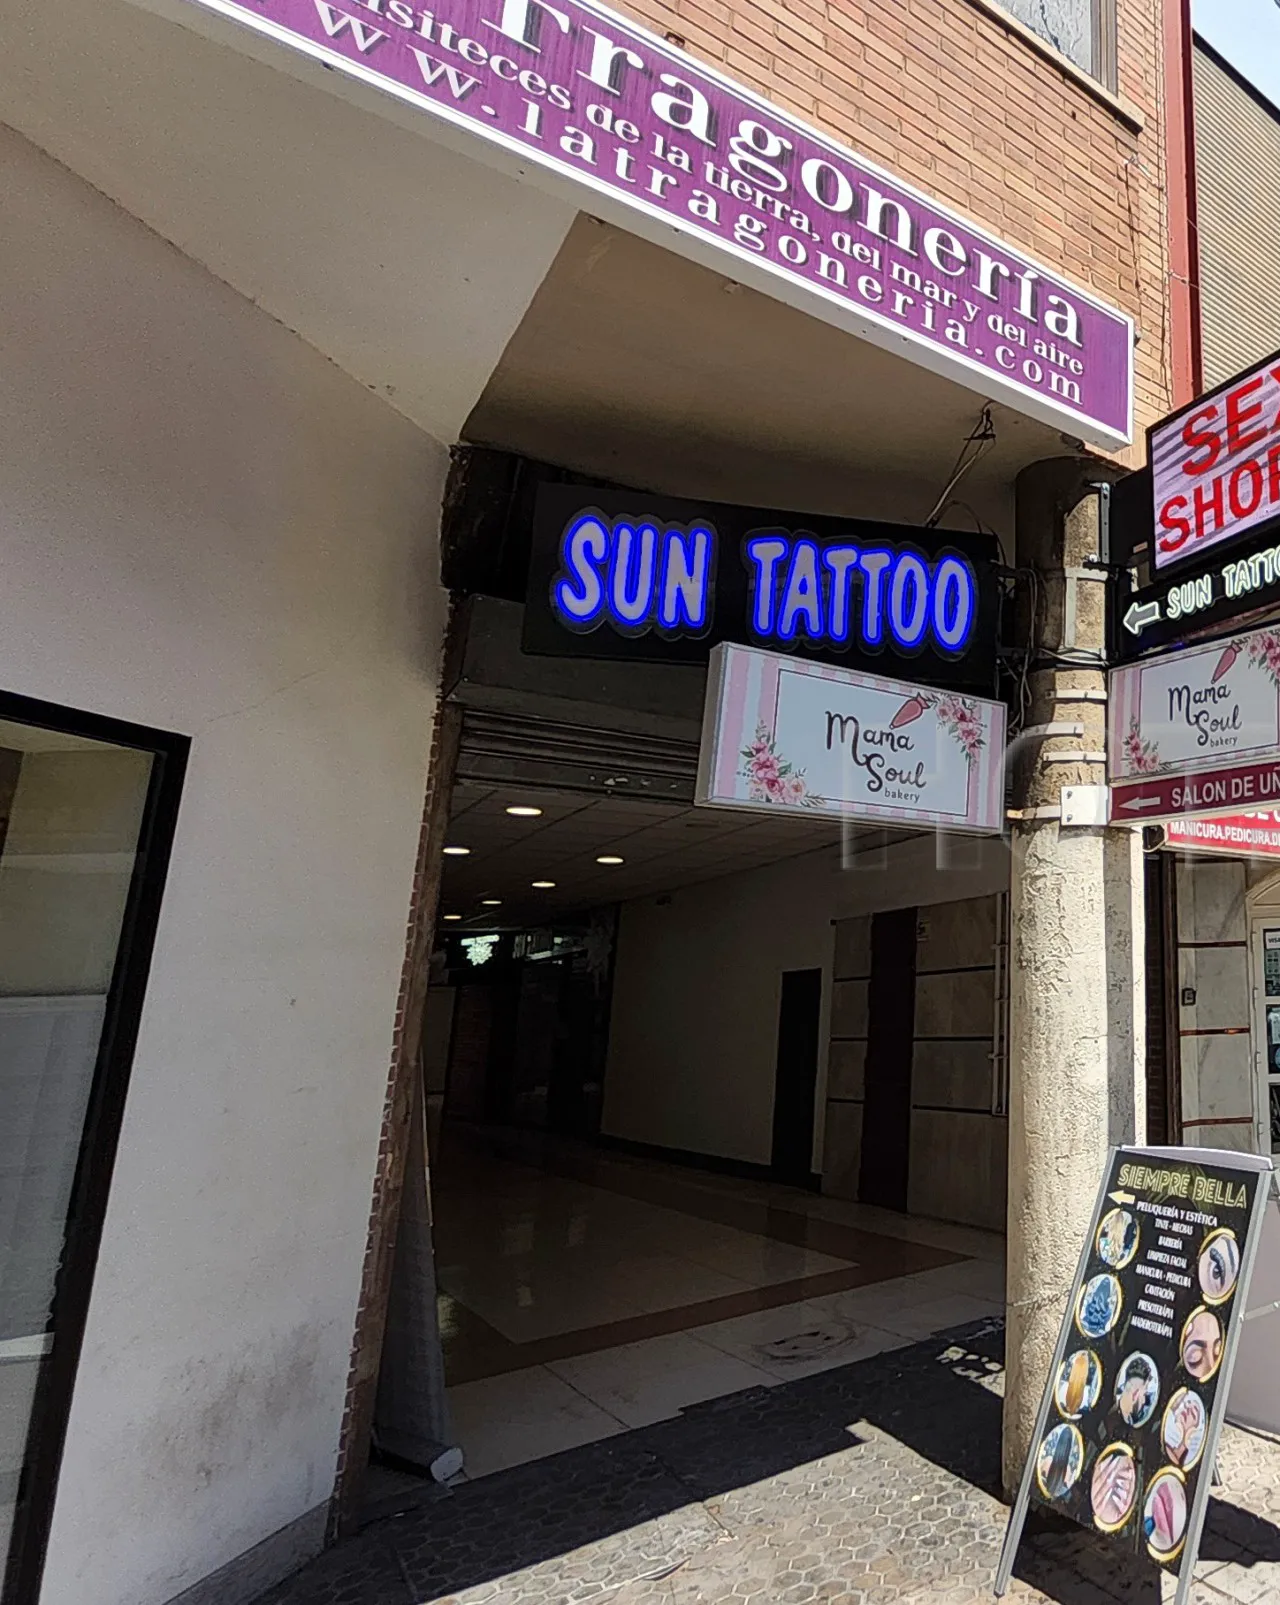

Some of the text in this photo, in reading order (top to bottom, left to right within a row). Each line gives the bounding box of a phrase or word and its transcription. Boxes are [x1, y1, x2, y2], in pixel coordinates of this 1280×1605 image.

[585, 103, 641, 144] de
[650, 132, 693, 175] la
[704, 161, 821, 242] tierra,
[832, 231, 882, 271] del
[890, 260, 957, 309] mar
[962, 299, 981, 322] y
[987, 314, 1028, 347] del
[1033, 338, 1083, 375] aire
[556, 514, 975, 652] SUN TATTOO
[1166, 574, 1213, 619] SUN
[1168, 684, 1231, 726] Mama
[1196, 704, 1242, 746] Soul
[825, 711, 915, 767] Mama
[1209, 736, 1238, 748] bakery
[864, 753, 927, 792] Soul
[1171, 781, 1226, 808] SALON
[1231, 776, 1254, 799] DE
[884, 787, 920, 803] bakery
[1117, 1163, 1247, 1209] SIEMPRE BELLA
[1136, 1200, 1218, 1227] PELUQUERÍA Y ESTÉTICA
